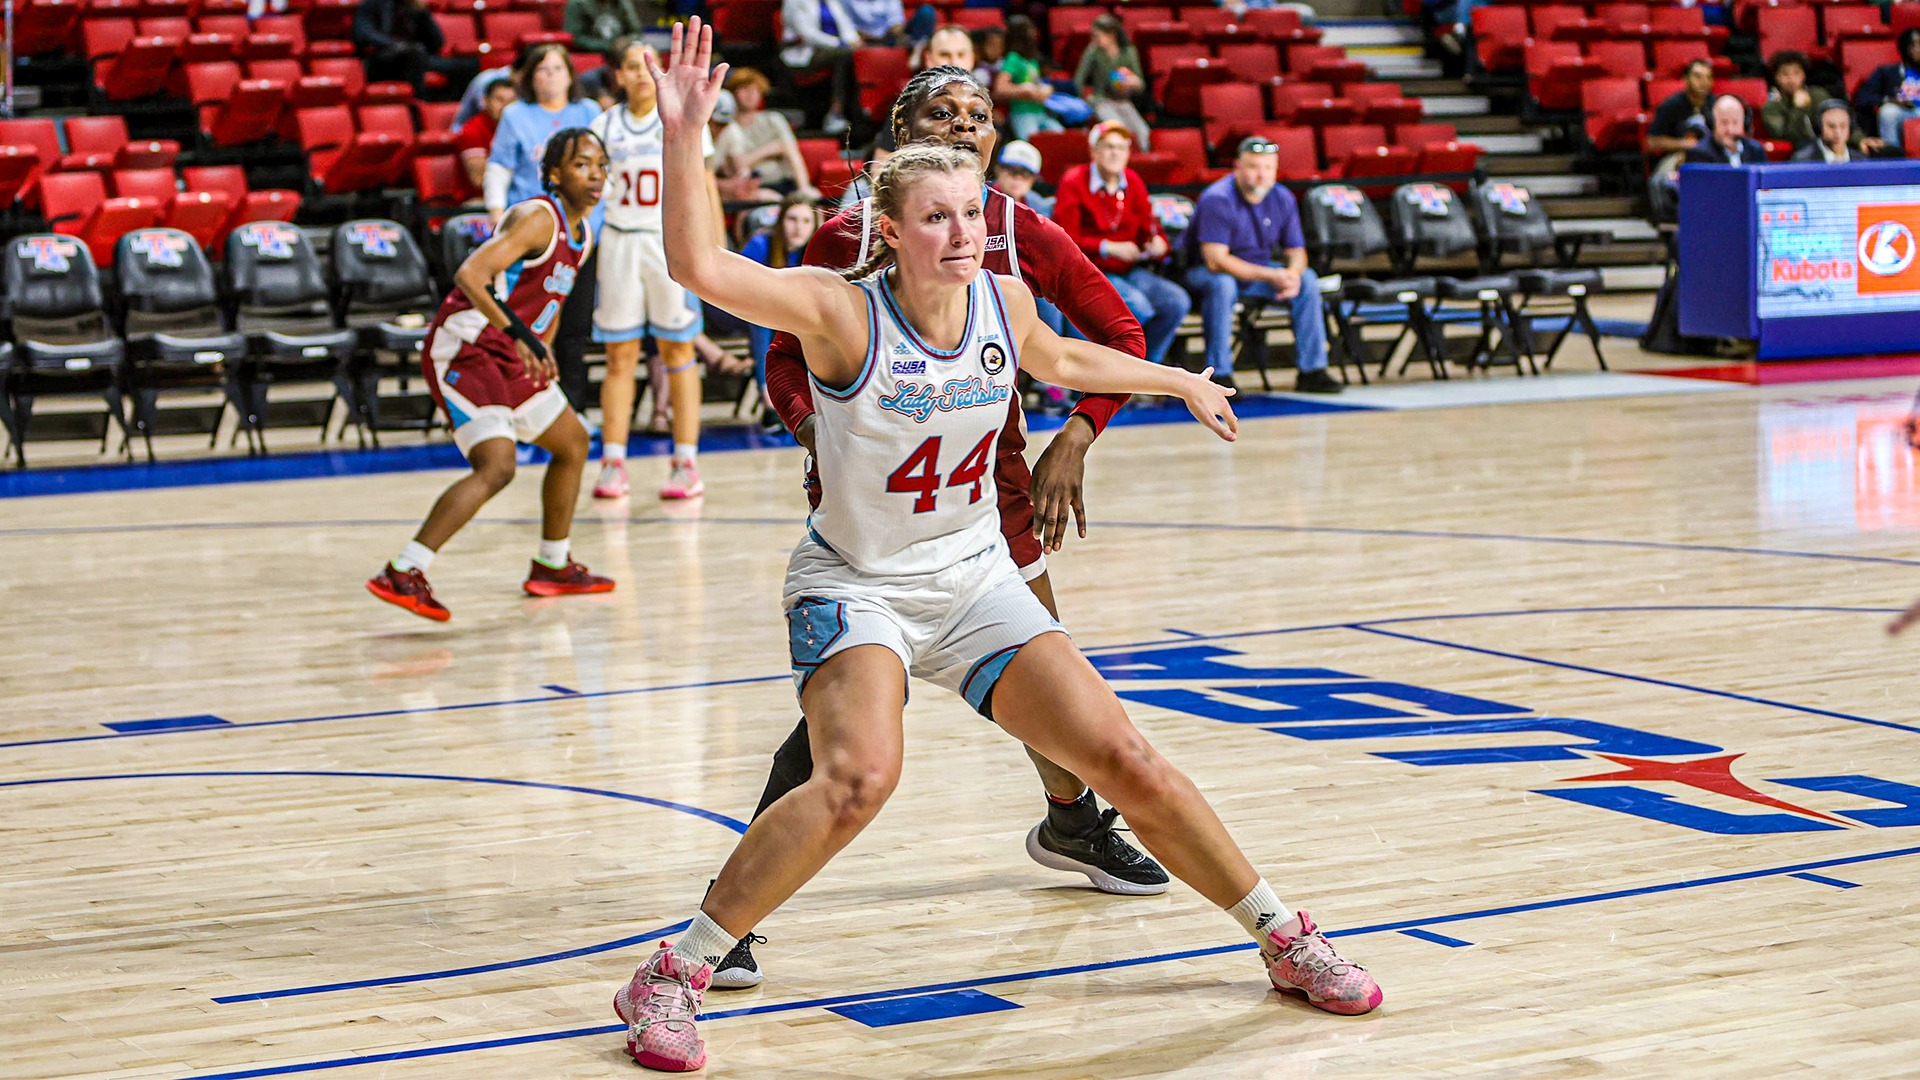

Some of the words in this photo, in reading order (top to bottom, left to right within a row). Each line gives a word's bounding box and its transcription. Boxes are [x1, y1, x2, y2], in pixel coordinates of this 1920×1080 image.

[985, 236, 1005, 246] USA
[1772, 258, 1853, 283] Kubota
[891, 360, 927, 370] C-USA
[878, 380, 937, 423] Lady
[935, 375, 1010, 411] Techsters
[885, 428, 998, 514] 44
